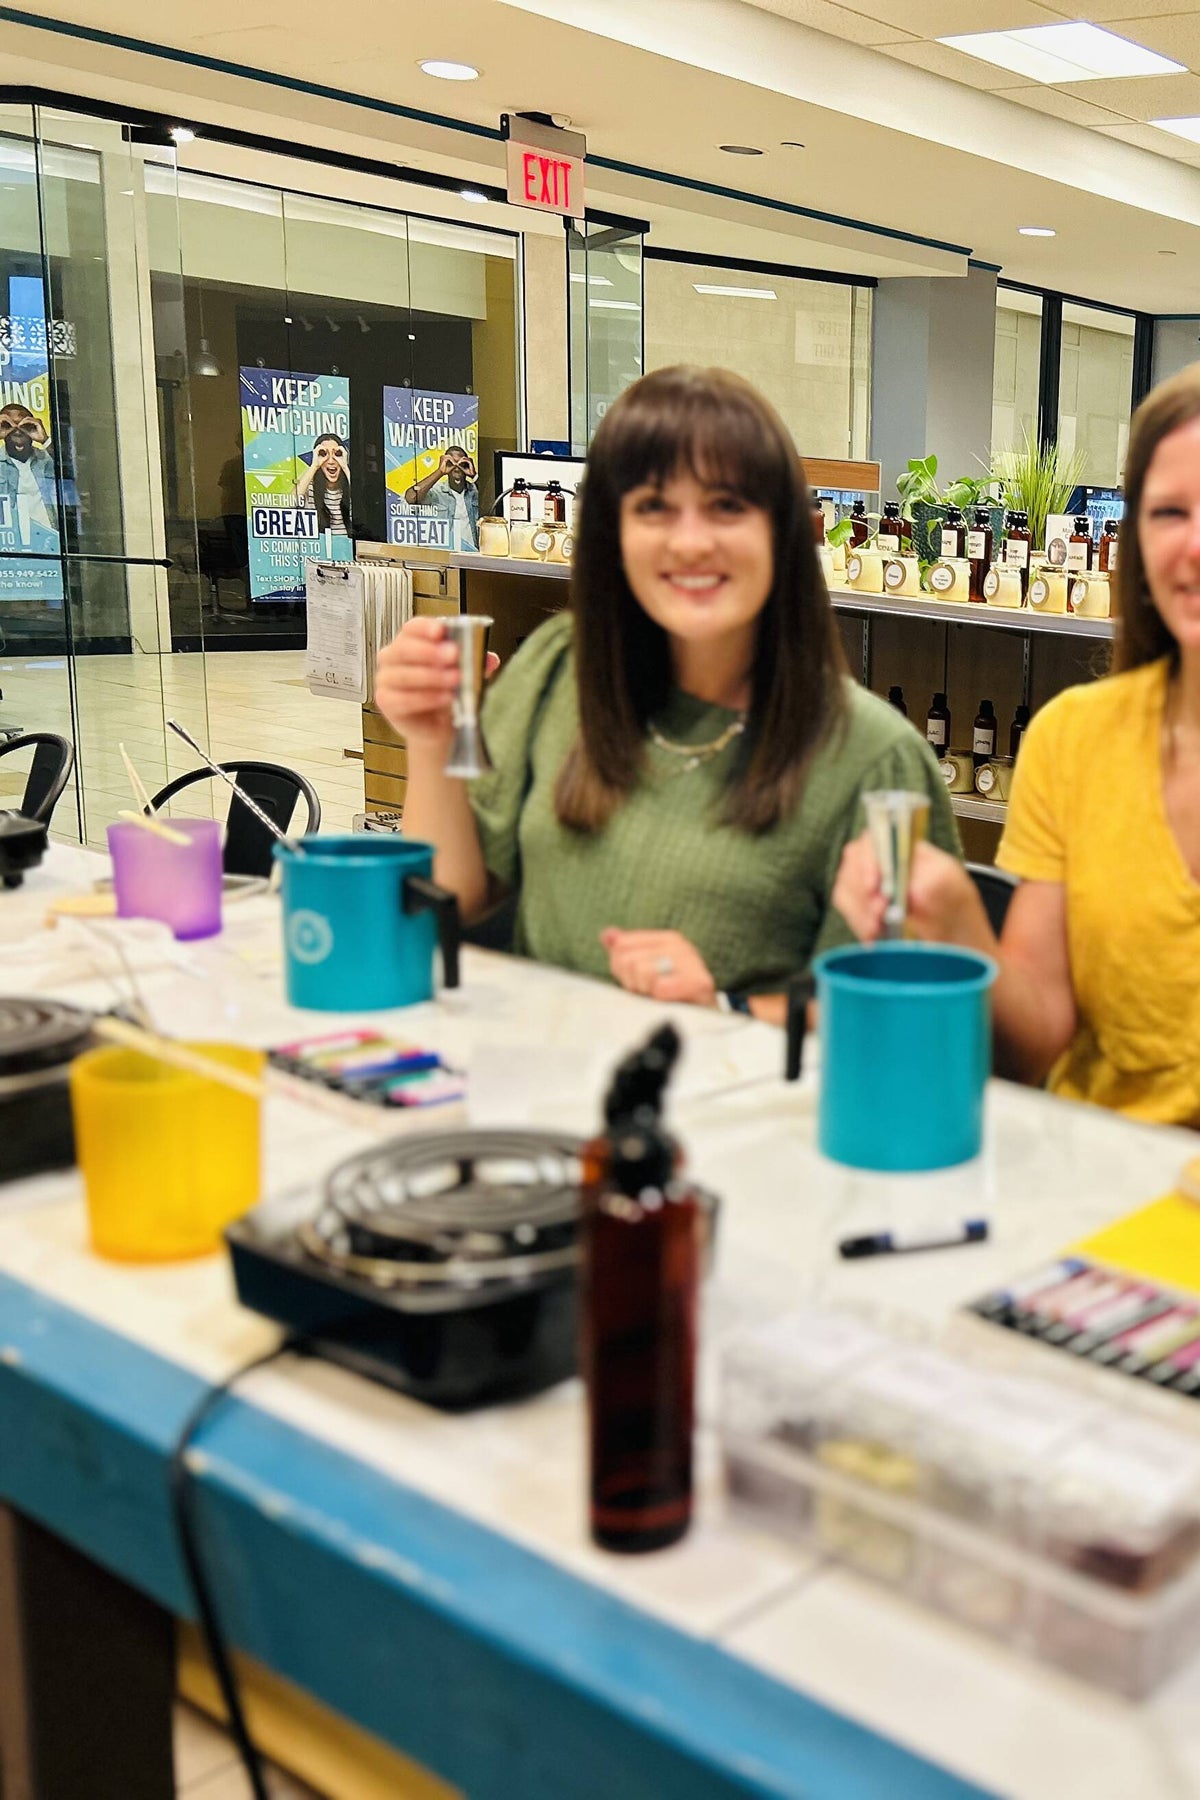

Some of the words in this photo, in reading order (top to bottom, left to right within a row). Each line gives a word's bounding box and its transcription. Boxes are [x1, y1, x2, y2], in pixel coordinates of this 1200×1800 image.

[523, 153, 571, 207] EXIT
[271, 378, 322, 407] KEEP
[246, 405, 348, 439] WATCHING
[412, 396, 455, 424] KEEP
[388, 422, 477, 453] WATCHING
[251, 493, 305, 508] SOMETHING
[390, 503, 439, 517] SOMETHING
[254, 509, 316, 536] GREAT
[393, 518, 448, 545] GREAT
[260, 540, 270, 552] IS
[271, 541, 307, 554] COMING
[308, 541, 321, 554] TO
[270, 555, 291, 567] THIS
[279, 584, 295, 592] stay
